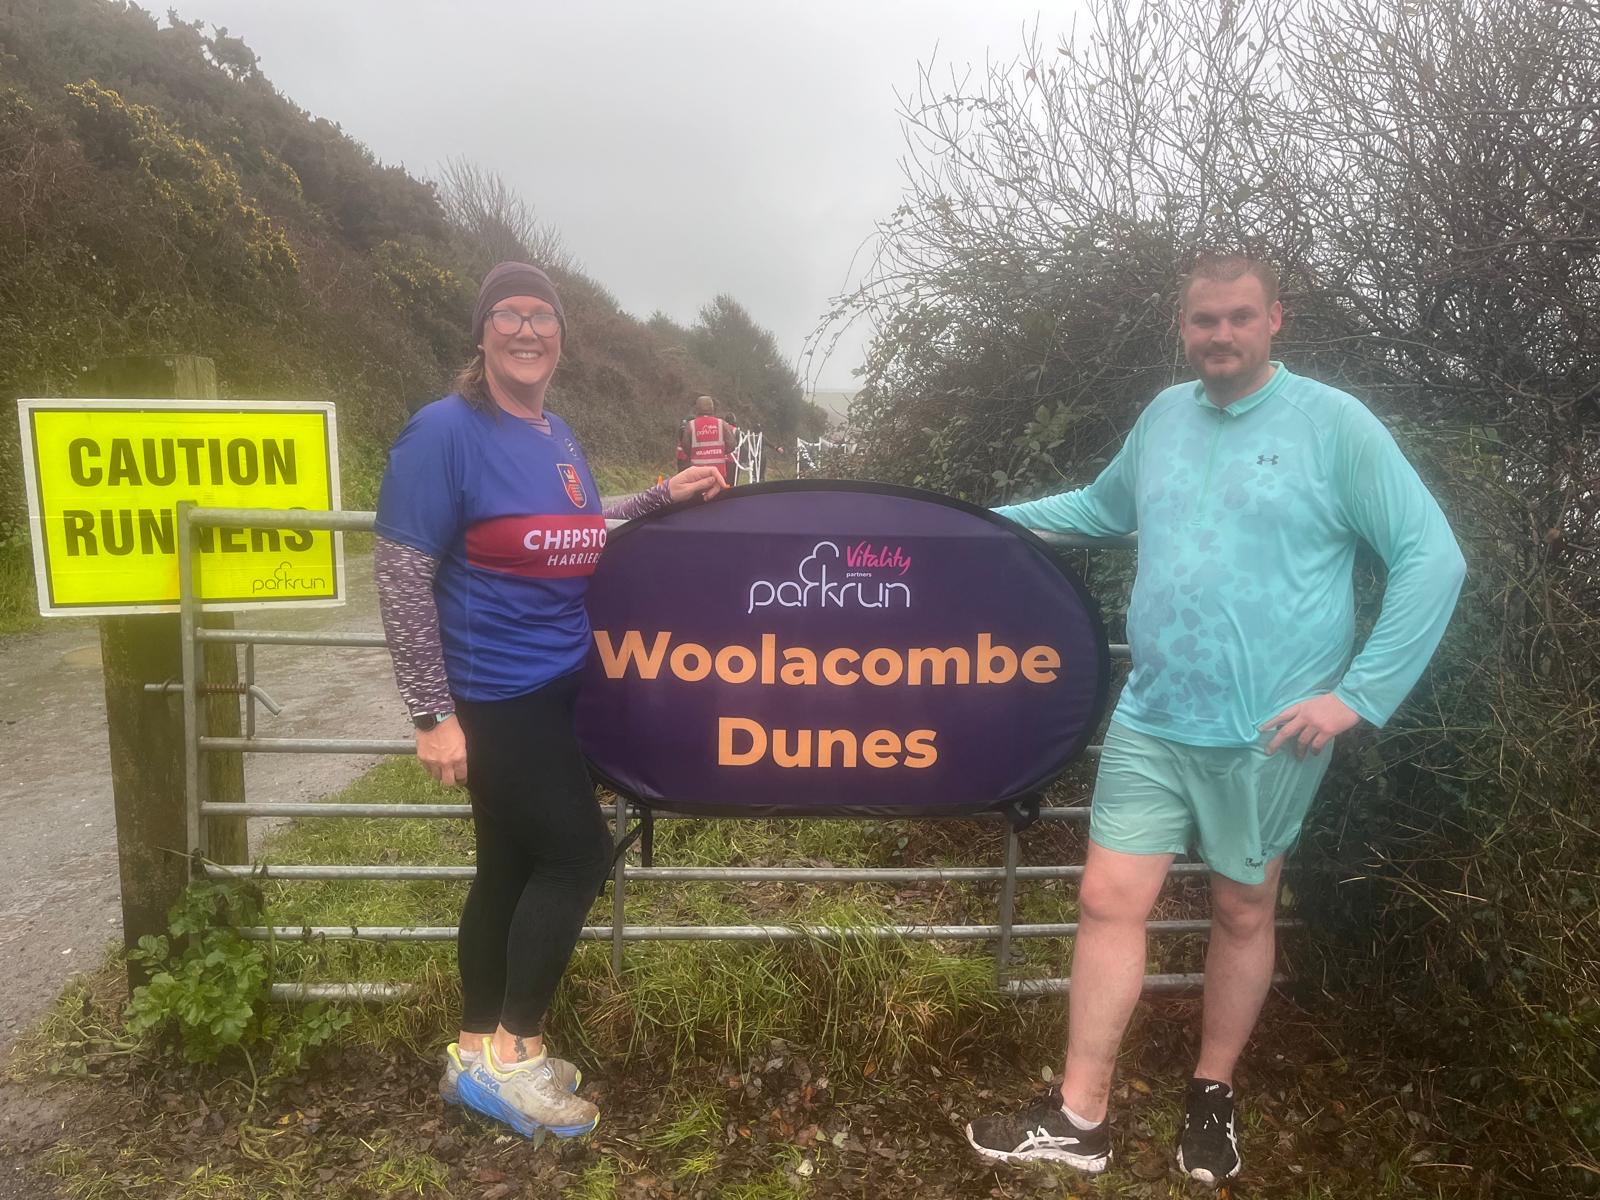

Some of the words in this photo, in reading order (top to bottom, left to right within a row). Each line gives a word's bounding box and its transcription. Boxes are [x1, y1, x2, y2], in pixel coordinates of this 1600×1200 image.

[68, 437, 298, 487] CAUTION
[523, 528, 607, 550] CHEPSTO
[846, 540, 912, 576] Vitality
[252, 569, 326, 594] parkrun
[747, 564, 912, 614] parkrun
[846, 571, 872, 579] partners
[593, 630, 1061, 686] Woolacombe
[718, 716, 938, 769] Dunes
